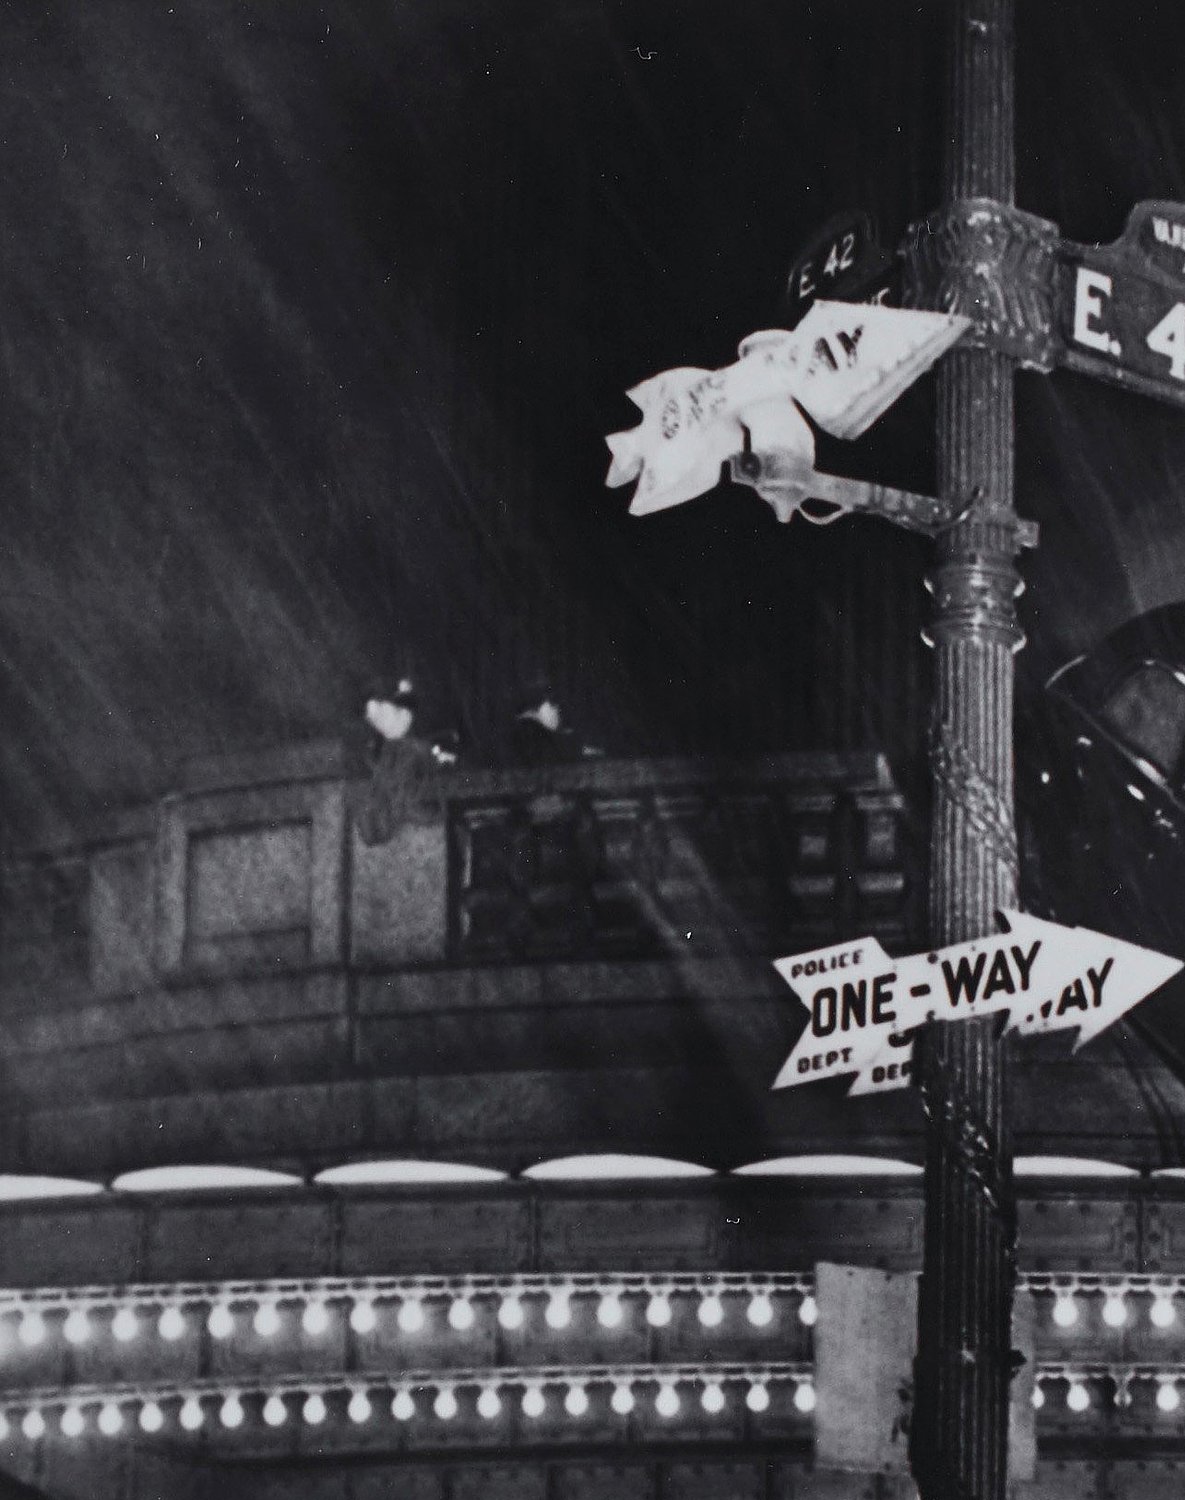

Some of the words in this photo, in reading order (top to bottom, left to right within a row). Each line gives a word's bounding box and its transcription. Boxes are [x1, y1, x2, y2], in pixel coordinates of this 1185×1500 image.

[823, 232, 855, 277] 42
[1073, 266, 1122, 357] E.
[791, 948, 864, 979] POLICE
[797, 1046, 853, 1074] DEPT
